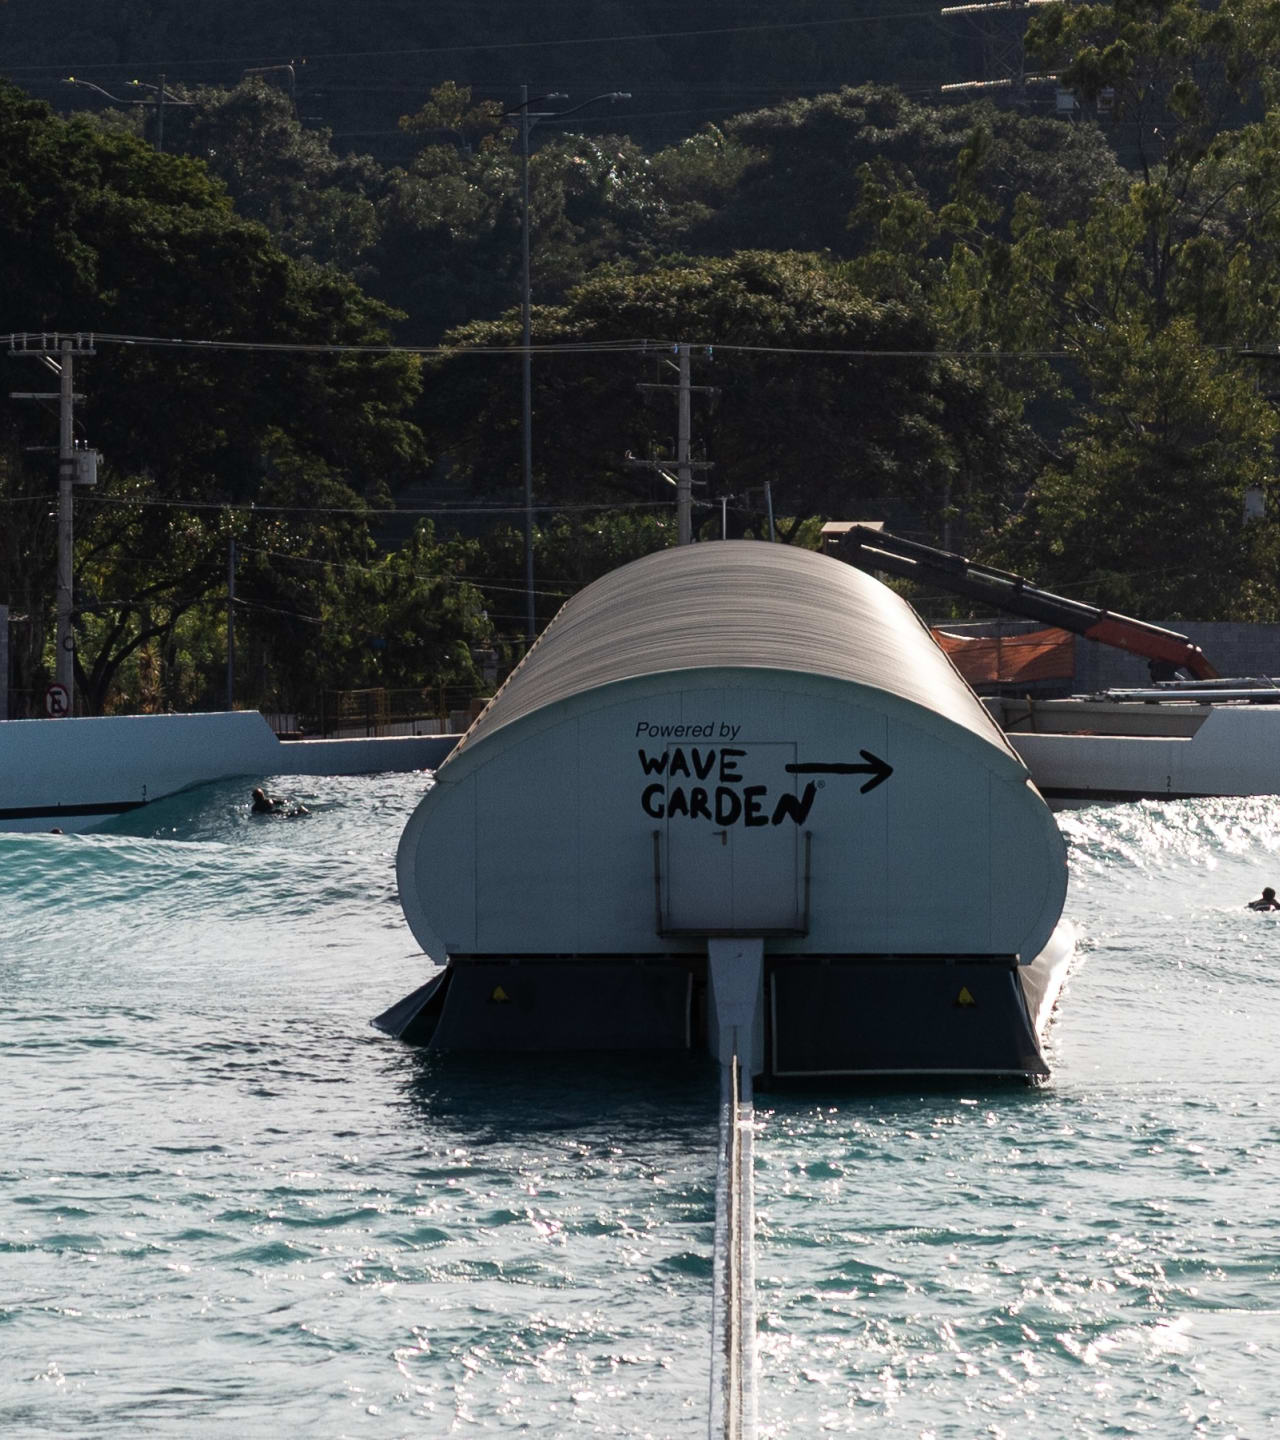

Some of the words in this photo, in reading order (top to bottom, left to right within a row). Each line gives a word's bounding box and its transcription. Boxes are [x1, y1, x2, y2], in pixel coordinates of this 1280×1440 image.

[634, 721, 715, 738] Powered
[718, 721, 741, 741] by
[638, 747, 747, 783] WAVE
[640, 779, 818, 827] GARDEN
